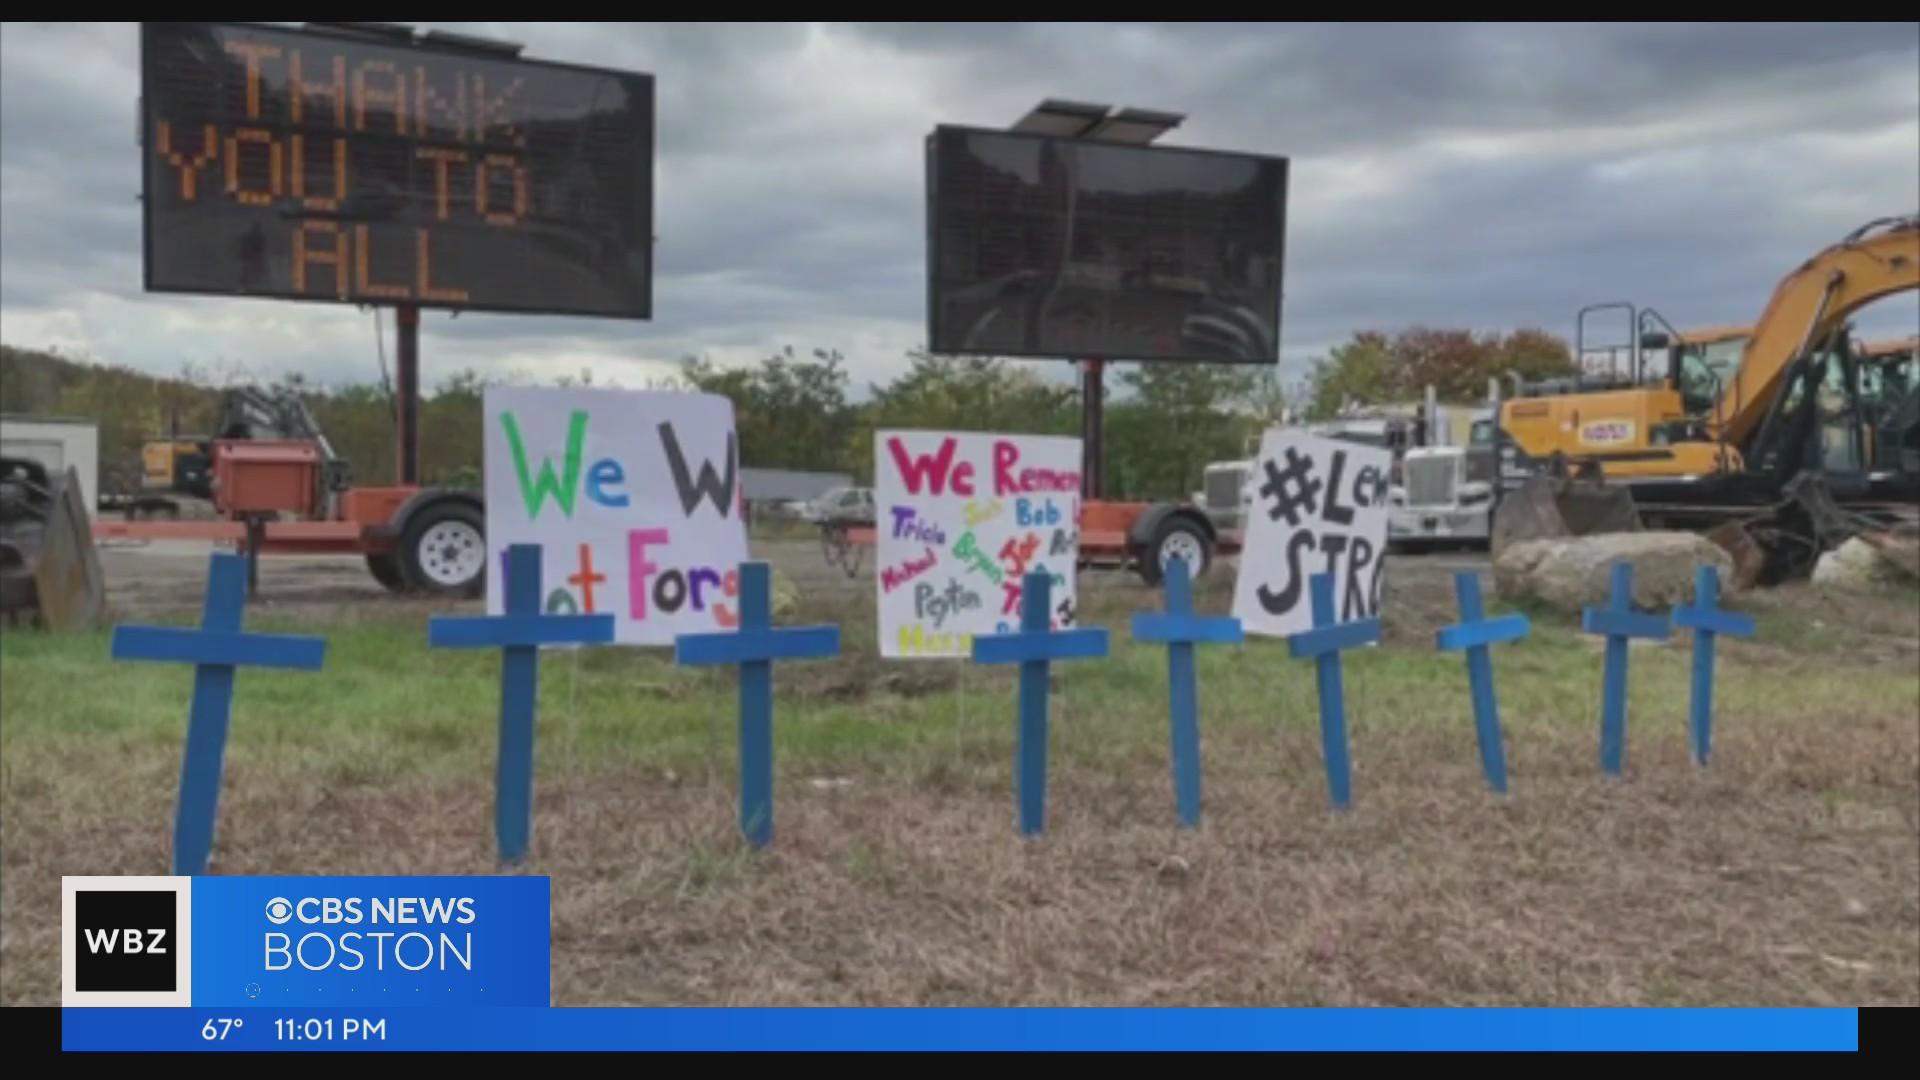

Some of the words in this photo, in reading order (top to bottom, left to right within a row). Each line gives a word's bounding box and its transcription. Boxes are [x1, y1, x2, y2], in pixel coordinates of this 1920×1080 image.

[223, 41, 524, 146] THANK
[156, 120, 347, 212] YOU
[416, 147, 527, 225] TO
[292, 219, 468, 300] ALL
[501, 410, 631, 519] We
[887, 437, 975, 496] We
[1015, 499, 1062, 527] Bob
[500, 543, 606, 615] ot
